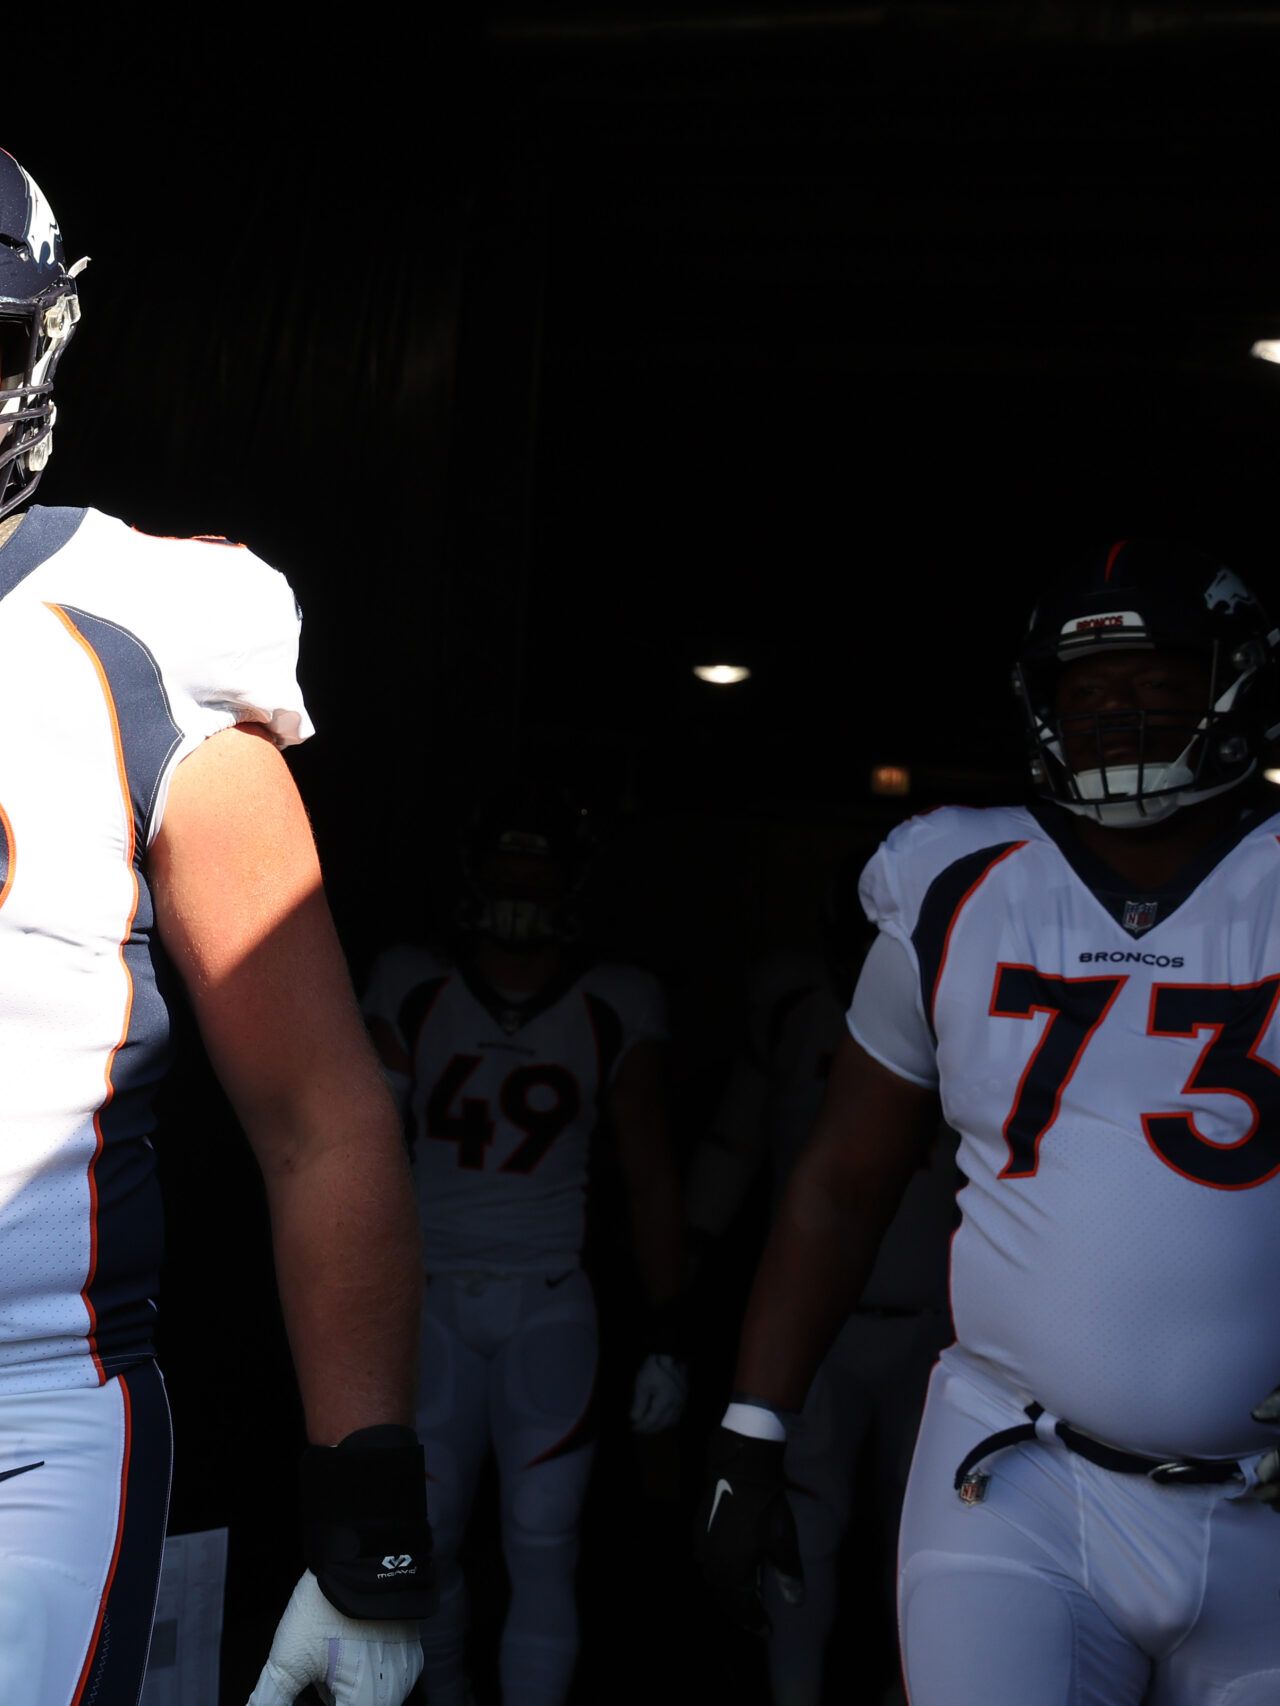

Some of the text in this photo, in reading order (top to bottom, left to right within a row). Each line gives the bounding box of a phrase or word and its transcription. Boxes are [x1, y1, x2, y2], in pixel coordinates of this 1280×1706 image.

[1079, 951, 1184, 968] BRONCOS
[426, 1053, 579, 1174] 49
[988, 961, 1280, 1191] 73
